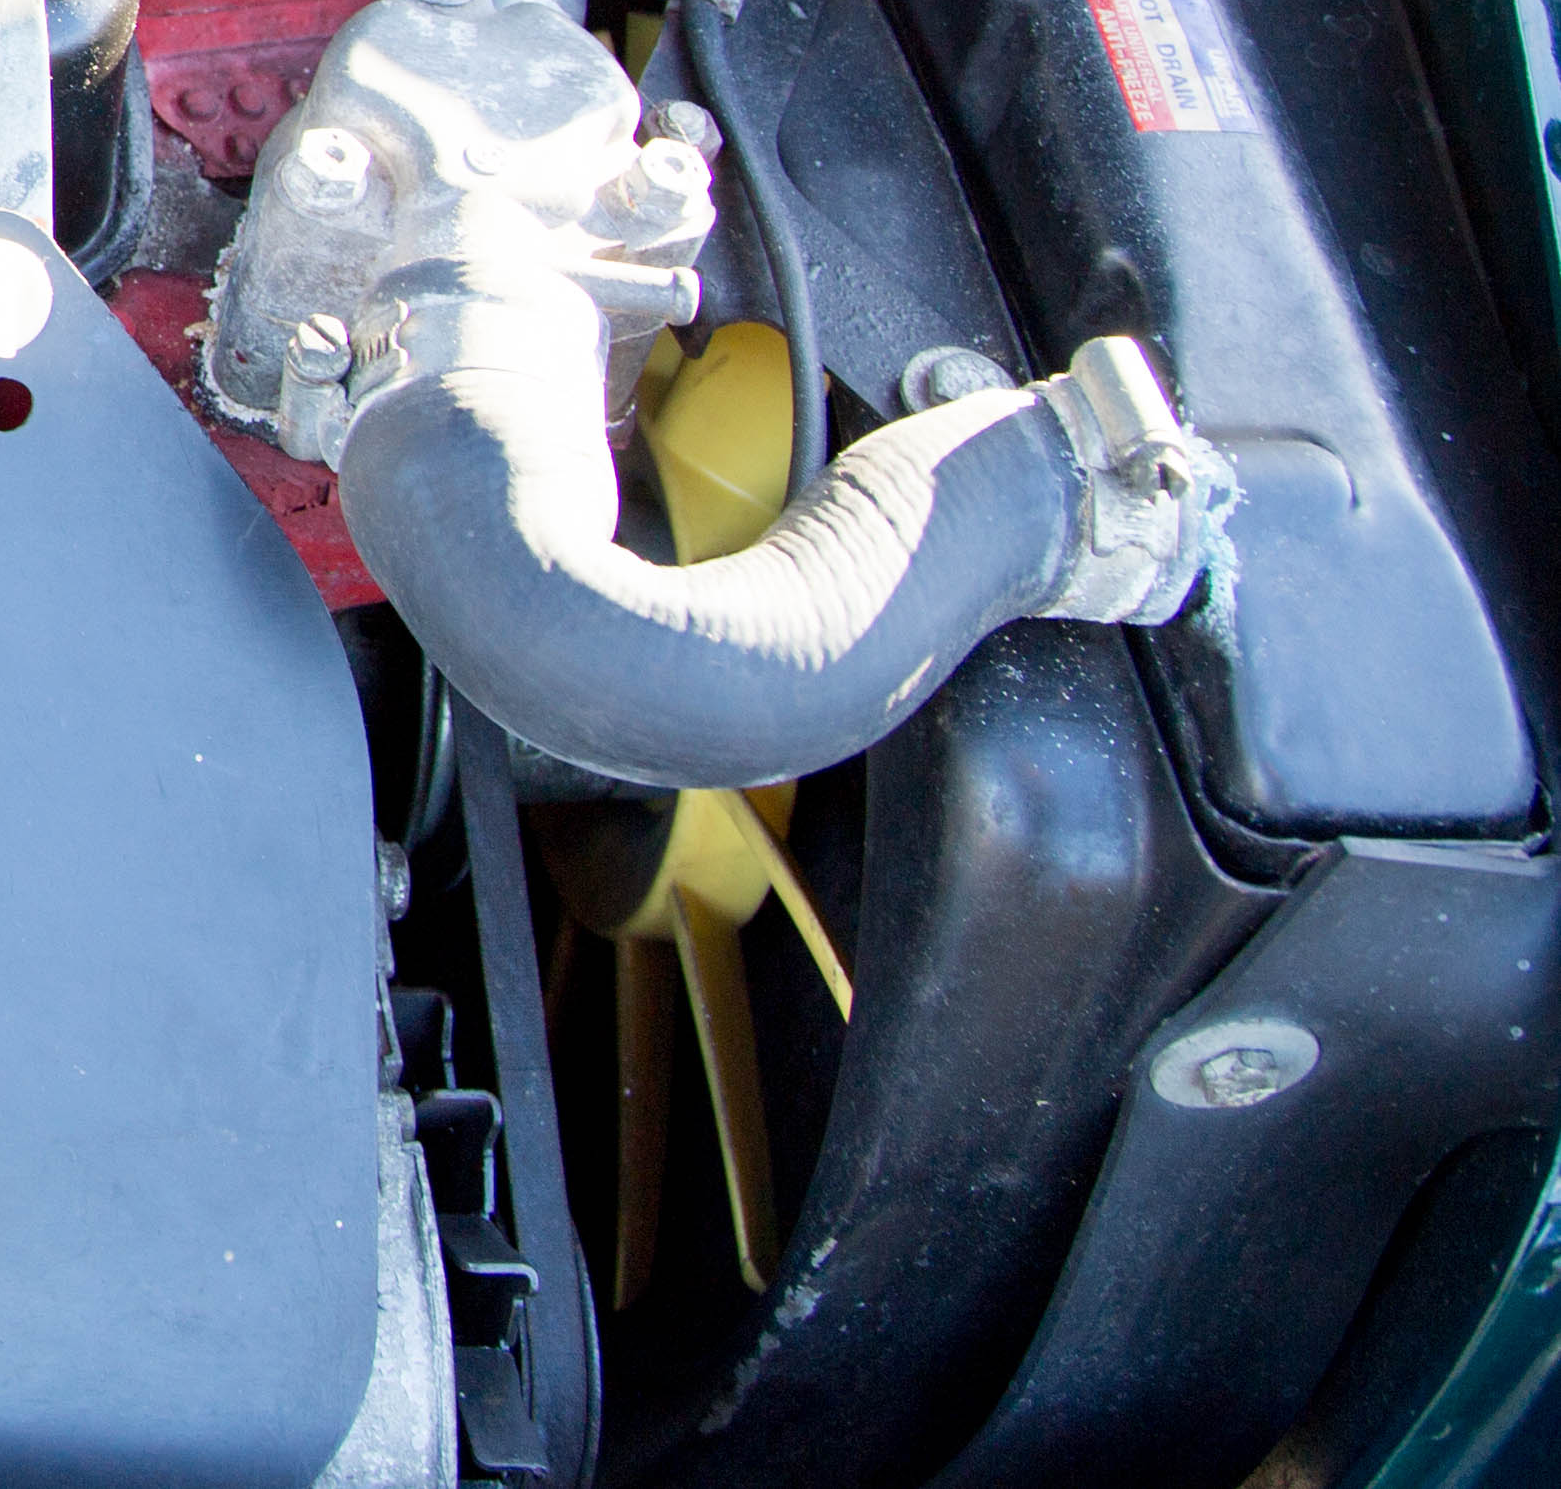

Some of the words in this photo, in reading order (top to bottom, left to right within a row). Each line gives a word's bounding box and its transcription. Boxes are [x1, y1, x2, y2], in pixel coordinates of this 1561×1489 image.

[1097, 8, 1155, 122] ANTI-FREEZE
[1122, 25, 1165, 104] UNIVERSAL
[1156, 43, 1198, 110] DRAIN
